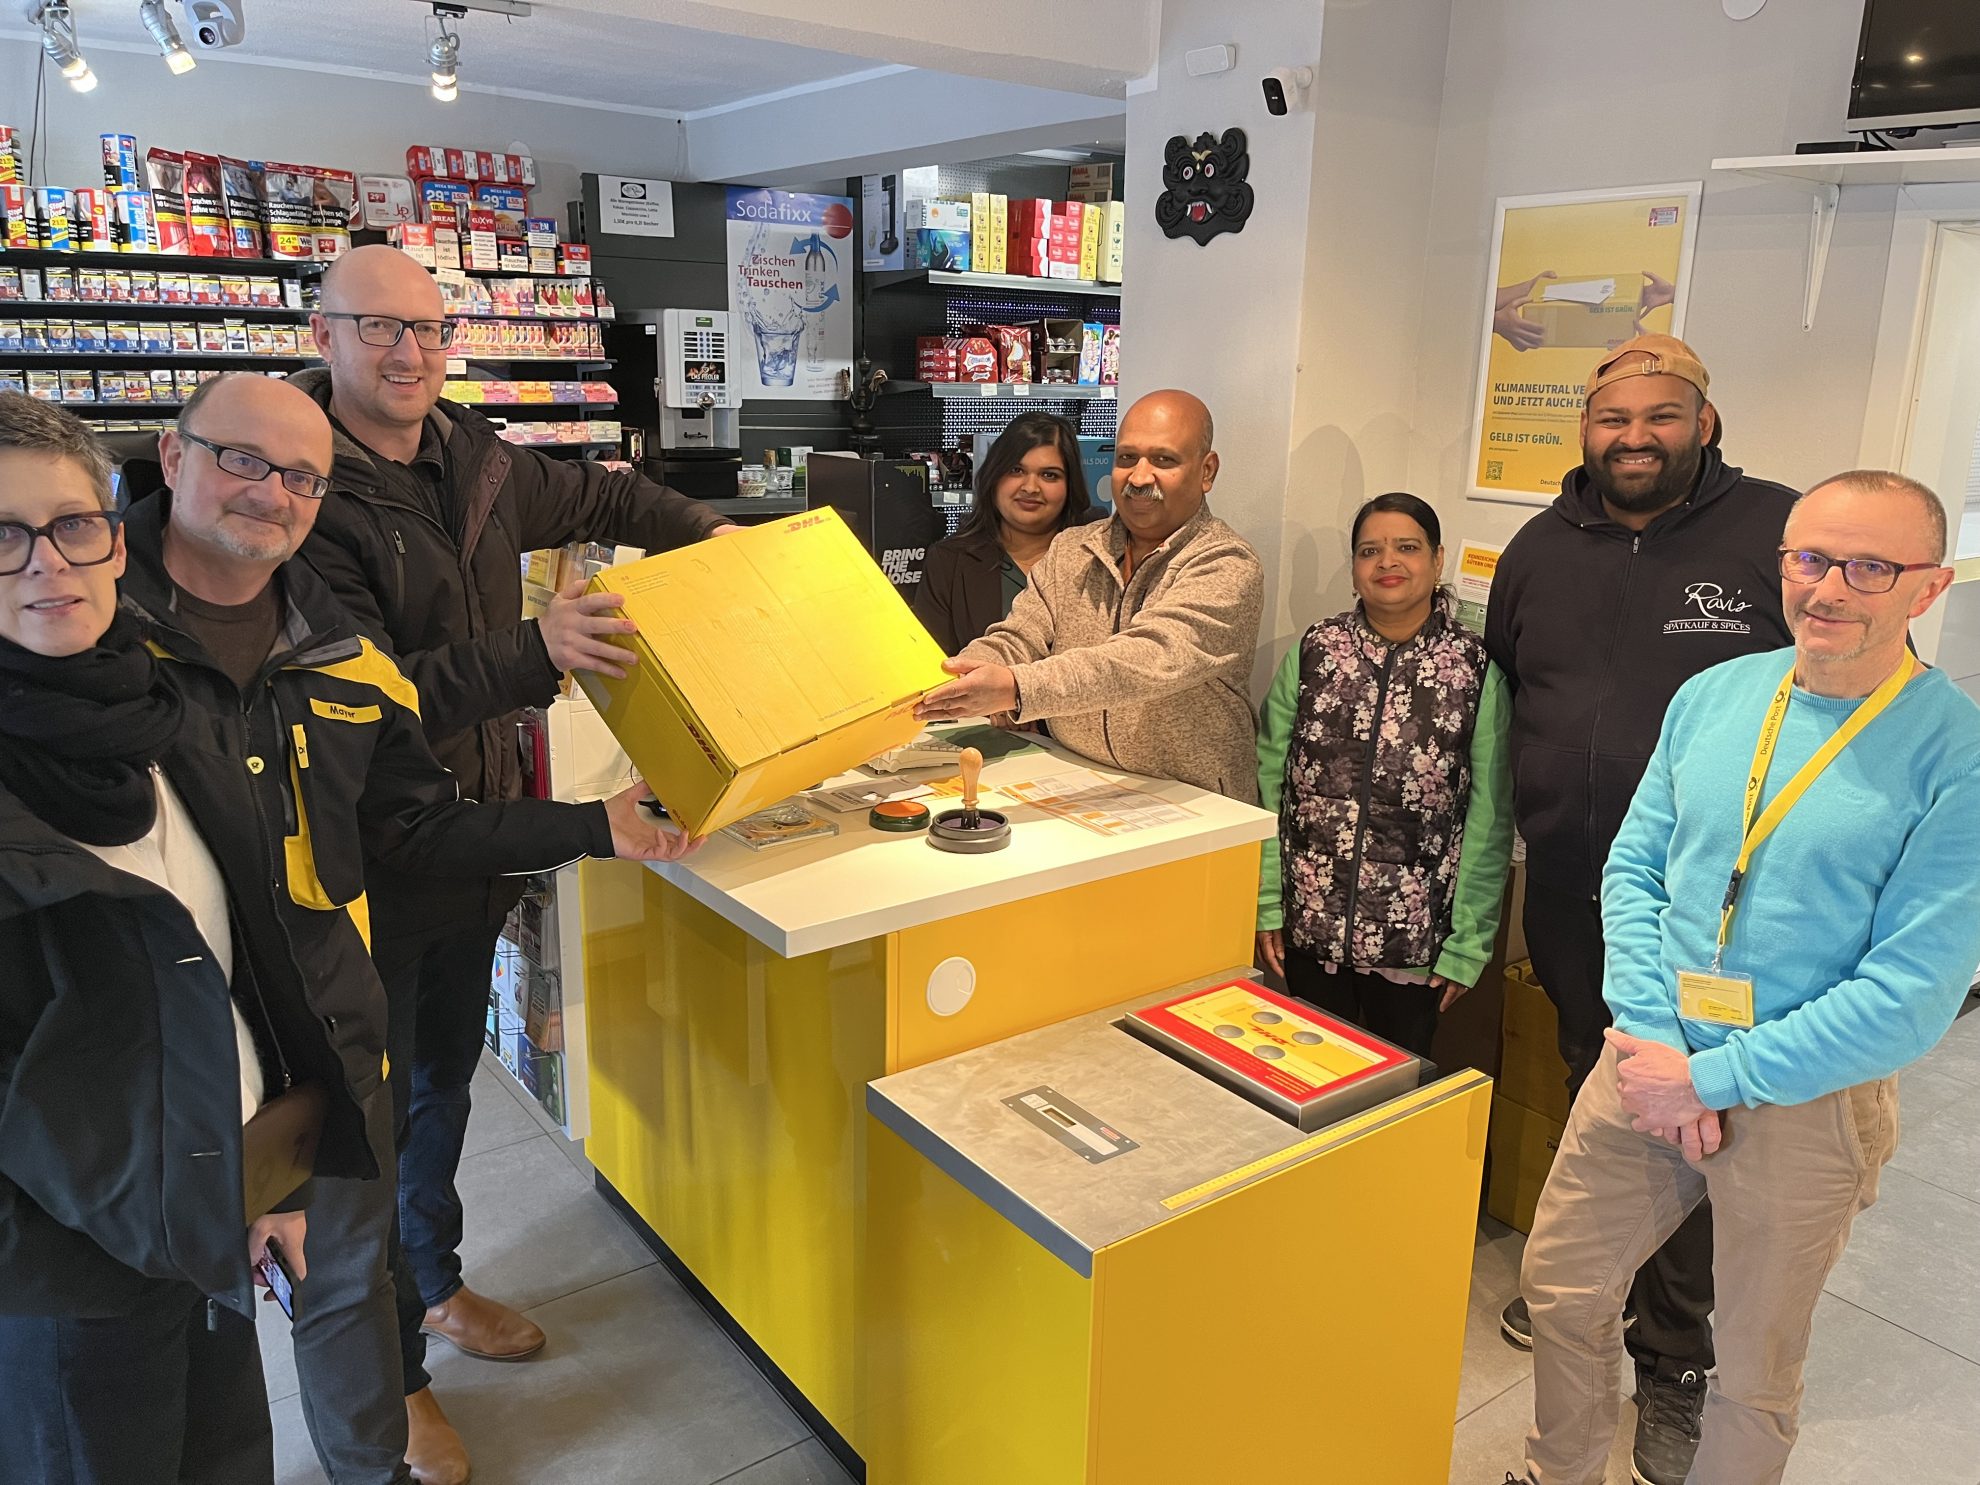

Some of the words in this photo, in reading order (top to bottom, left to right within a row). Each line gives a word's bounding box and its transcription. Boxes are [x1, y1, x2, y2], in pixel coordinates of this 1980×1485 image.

[736, 200, 812, 222] Sodafixx
[752, 254, 795, 267] Zischen
[738, 265, 780, 277] Trinken
[747, 277, 802, 289] Tauschen
[1494, 383, 1570, 395] KLIMANEUTRAL
[1494, 396, 1514, 405] UND
[1515, 397, 1544, 407] JETZT
[1546, 398, 1573, 408] AUCH
[1490, 432, 1513, 442] GELB
[1515, 434, 1530, 443] IST
[1532, 433, 1562, 445] GRÜN.
[788, 516, 824, 532] DHL
[883, 548, 925, 561] BRING
[882, 561, 909, 573] THE
[1685, 582, 1752, 618] Ravi's
[1720, 622, 1750, 631] SPICES
[330, 706, 355, 718] Mayer
[1760, 721, 1776, 755] Deutsche
[1771, 706, 1782, 721] Post
[688, 723, 717, 767] DHL
